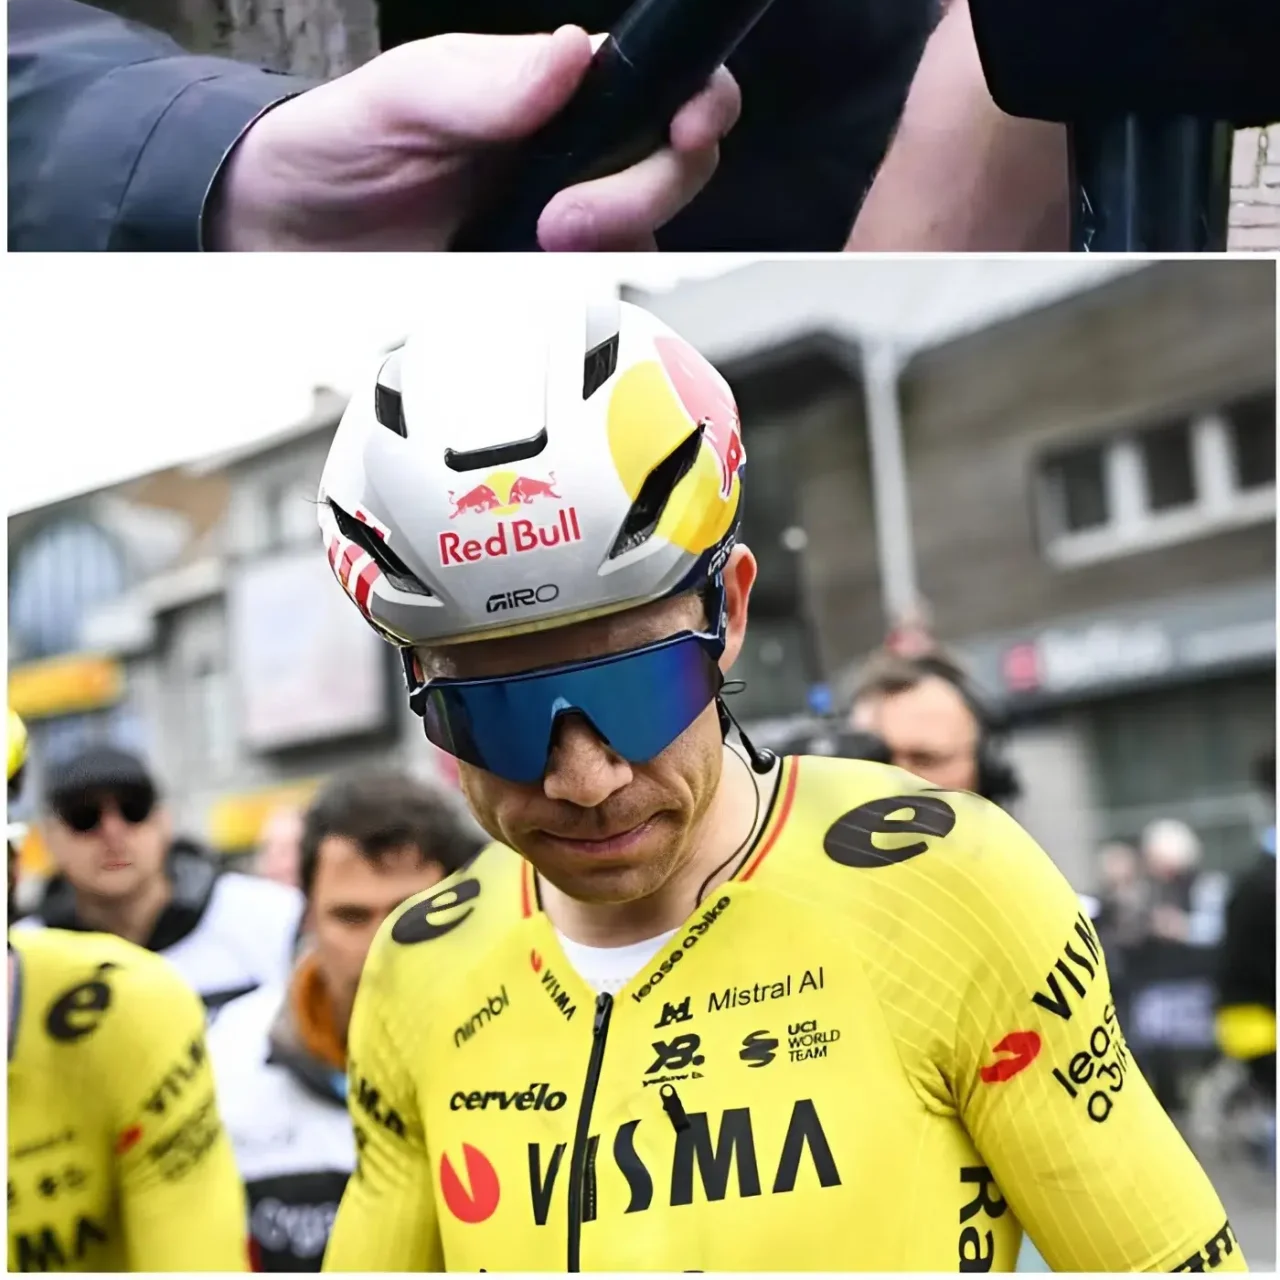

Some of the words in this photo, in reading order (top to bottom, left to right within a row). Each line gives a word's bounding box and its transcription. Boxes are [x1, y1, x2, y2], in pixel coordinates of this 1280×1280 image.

[438, 530, 507, 566] Red
[514, 506, 582, 553] Bull
[485, 583, 560, 613] GIRO
[1031, 910, 1101, 1021] VISM
[541, 969, 577, 1021] VISMA
[707, 974, 791, 1013] Mistral
[454, 984, 509, 1048] nimbl
[787, 1019, 817, 1036] UCI
[788, 1029, 840, 1049] WORLD
[788, 1045, 828, 1063] TEAM
[449, 1083, 568, 1112] cervélo
[528, 1098, 842, 1226] VISMA
